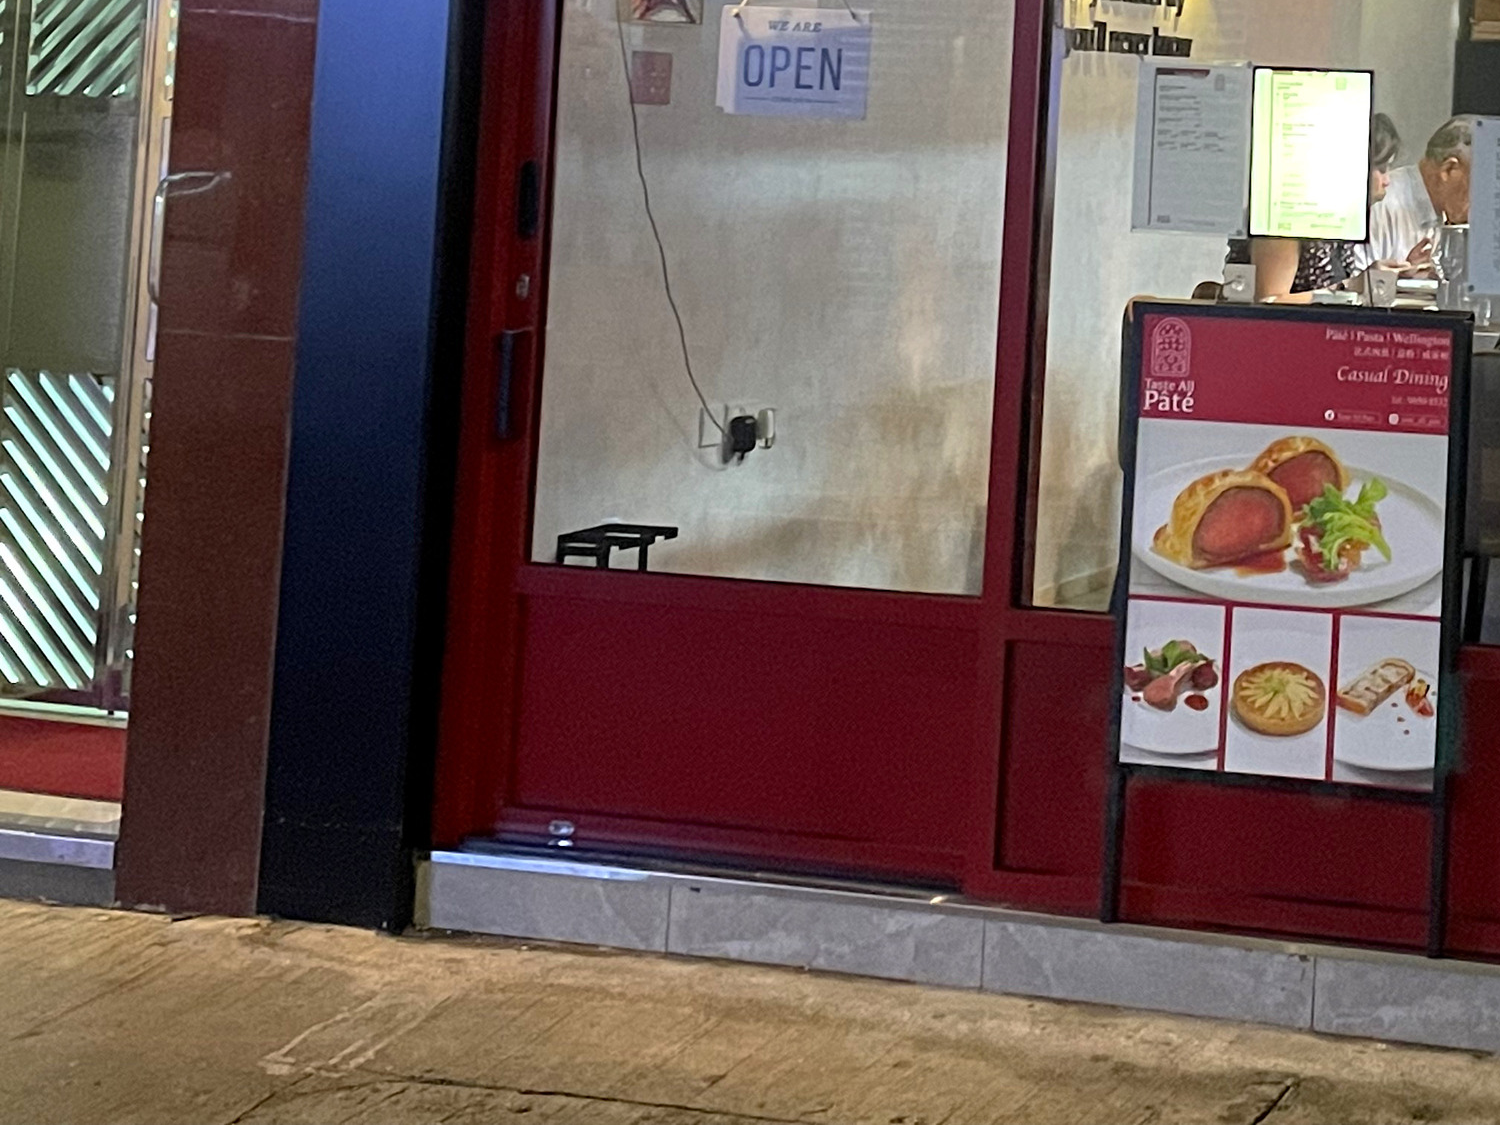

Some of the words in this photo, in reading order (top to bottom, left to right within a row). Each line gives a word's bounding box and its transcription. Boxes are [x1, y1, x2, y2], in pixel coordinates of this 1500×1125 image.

[768, 20, 790, 32] WE
[792, 21, 823, 33] ARE
[743, 44, 843, 91] OPEN
[1336, 364, 1393, 384] Casual
[1393, 368, 1449, 395] Dining
[1142, 389, 1195, 413] Pâté
